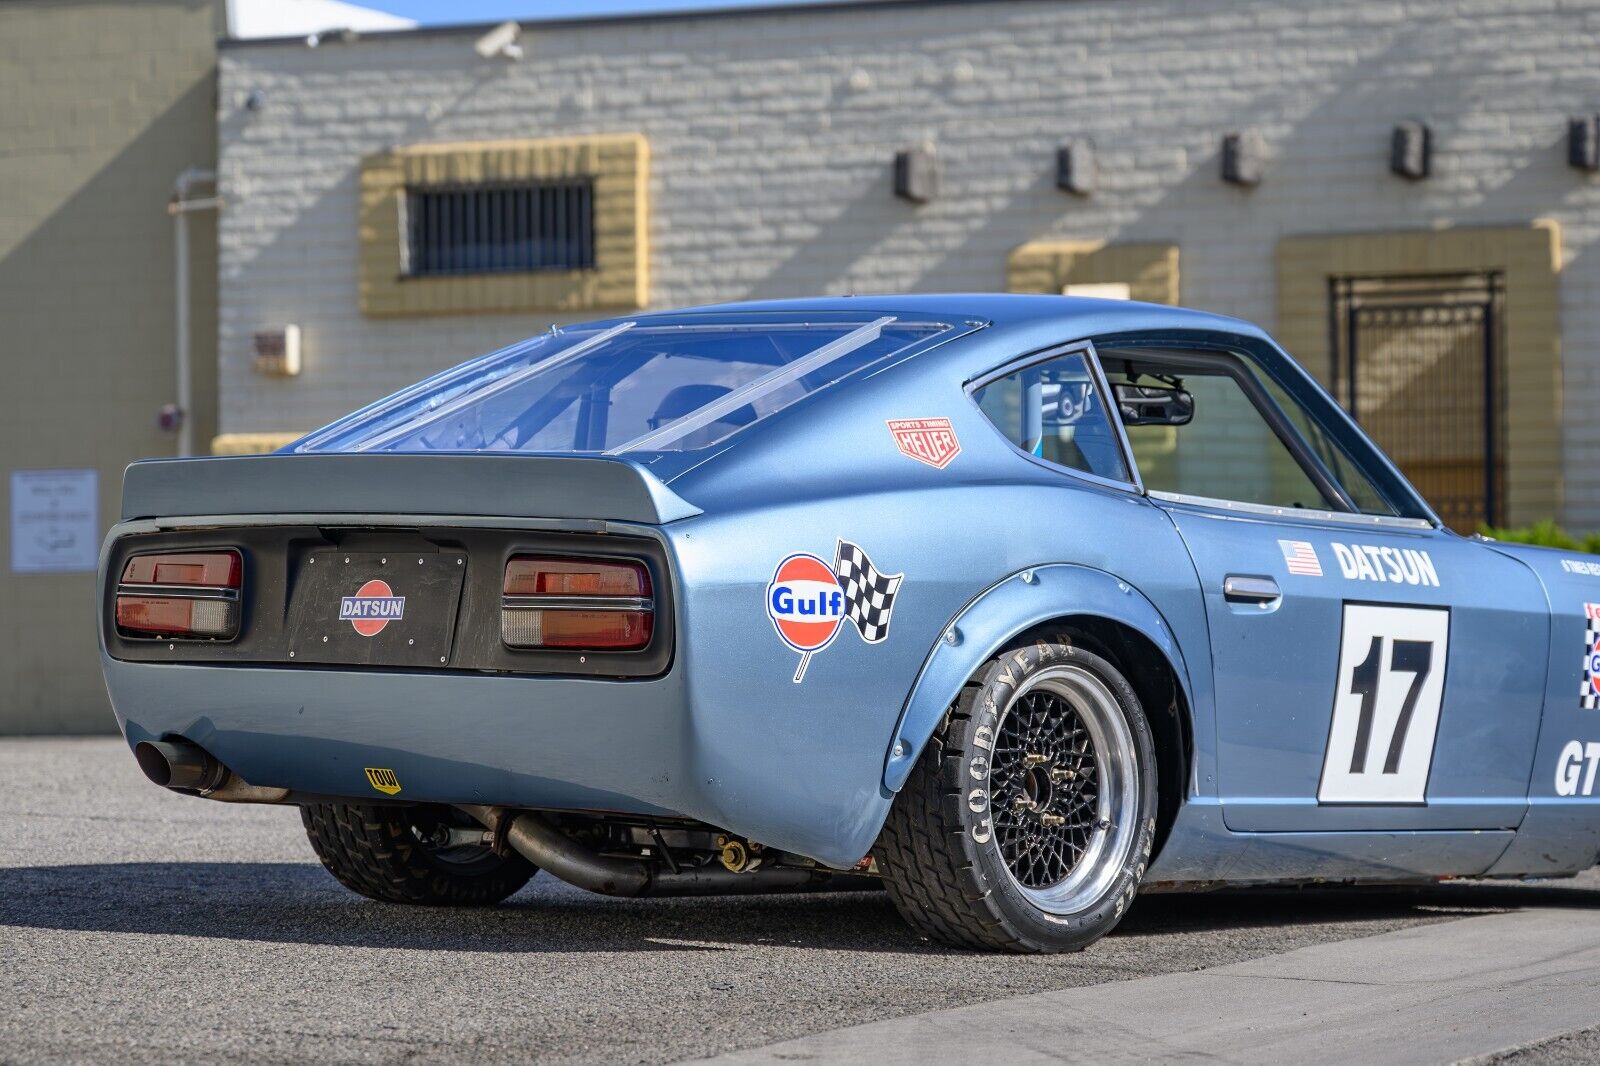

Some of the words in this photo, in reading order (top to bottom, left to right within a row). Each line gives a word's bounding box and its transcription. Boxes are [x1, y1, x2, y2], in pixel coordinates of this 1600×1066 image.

[899, 431, 955, 462] HEUER
[1331, 542, 1441, 588] DATSUN
[342, 600, 402, 617] DATSUN
[772, 586, 842, 616] Gulf
[1349, 635, 1435, 775] 17
[365, 769, 398, 787] TOW
[1554, 740, 1600, 797] GT
